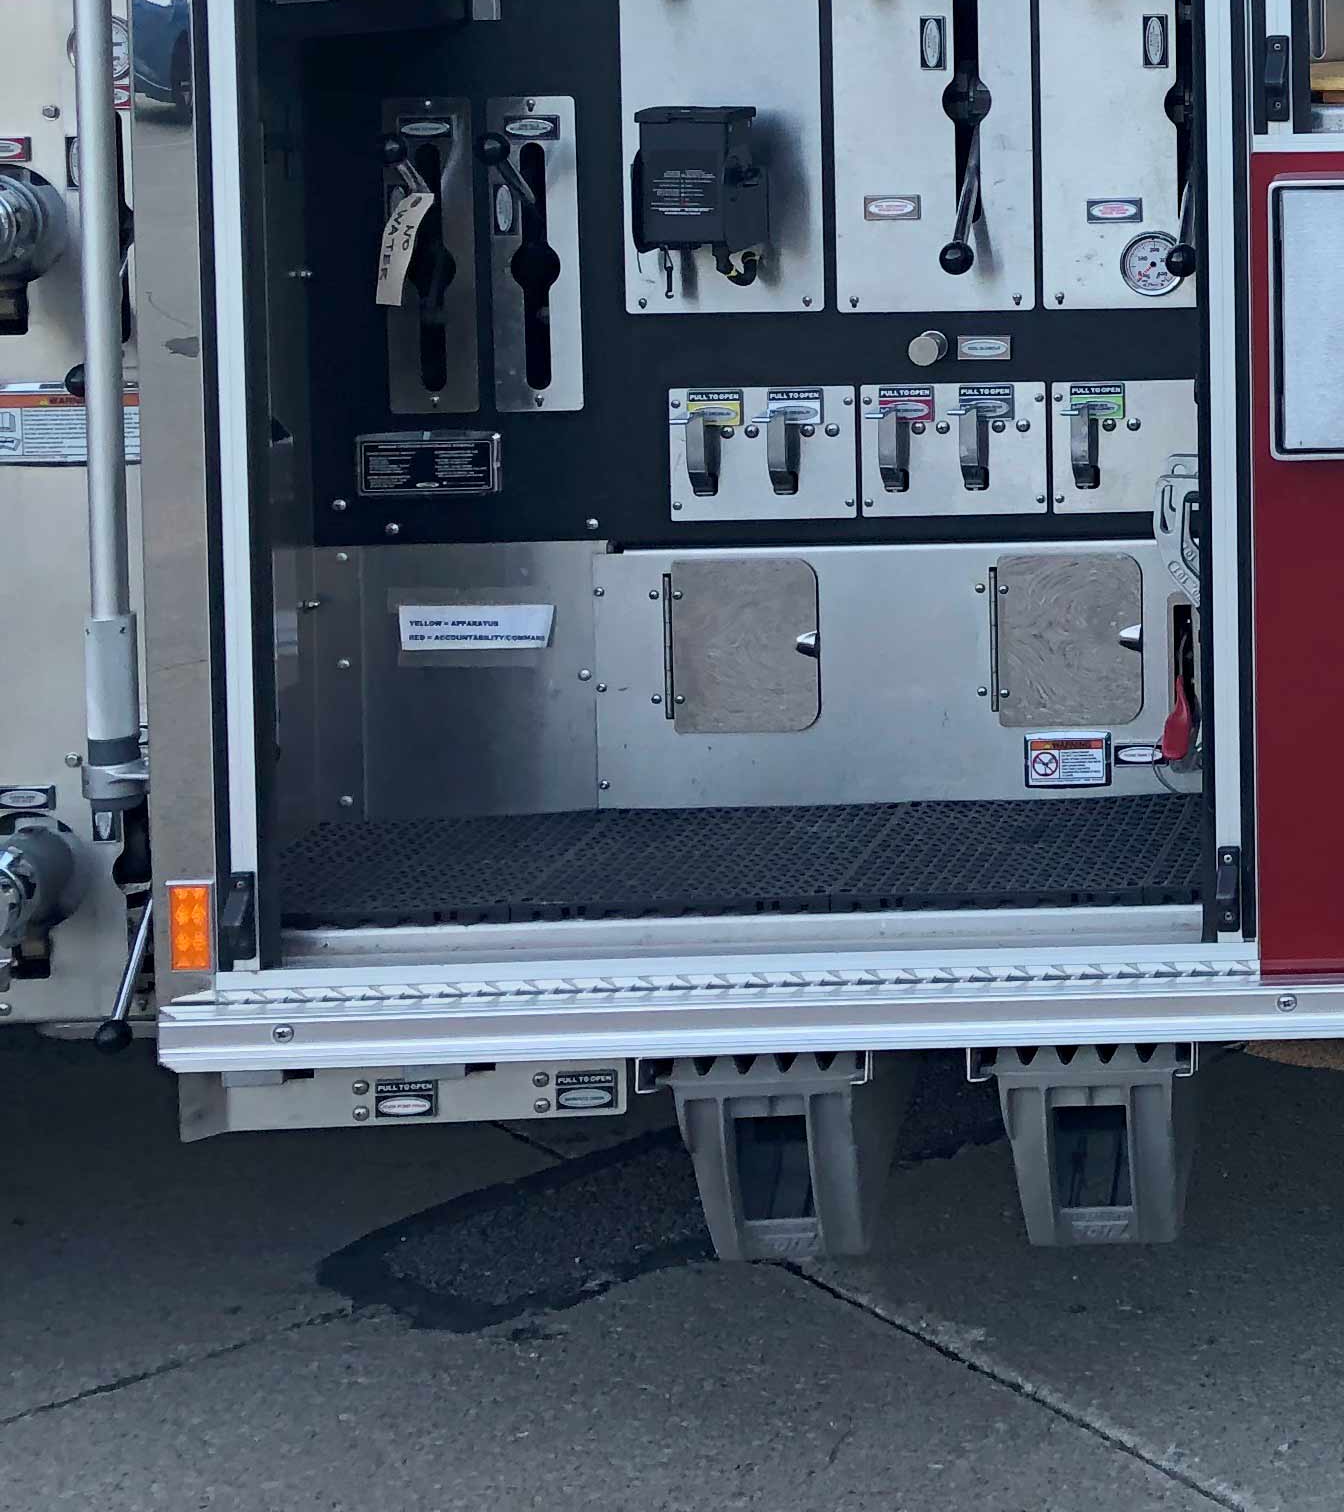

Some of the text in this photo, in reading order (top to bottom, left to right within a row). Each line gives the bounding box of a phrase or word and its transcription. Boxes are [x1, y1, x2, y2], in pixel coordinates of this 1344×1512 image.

[379, 209, 408, 281] WATER
[401, 224, 415, 251] NO
[689, 393, 707, 401] PULL
[719, 392, 739, 400] OPEN
[799, 391, 820, 399] OPEN
